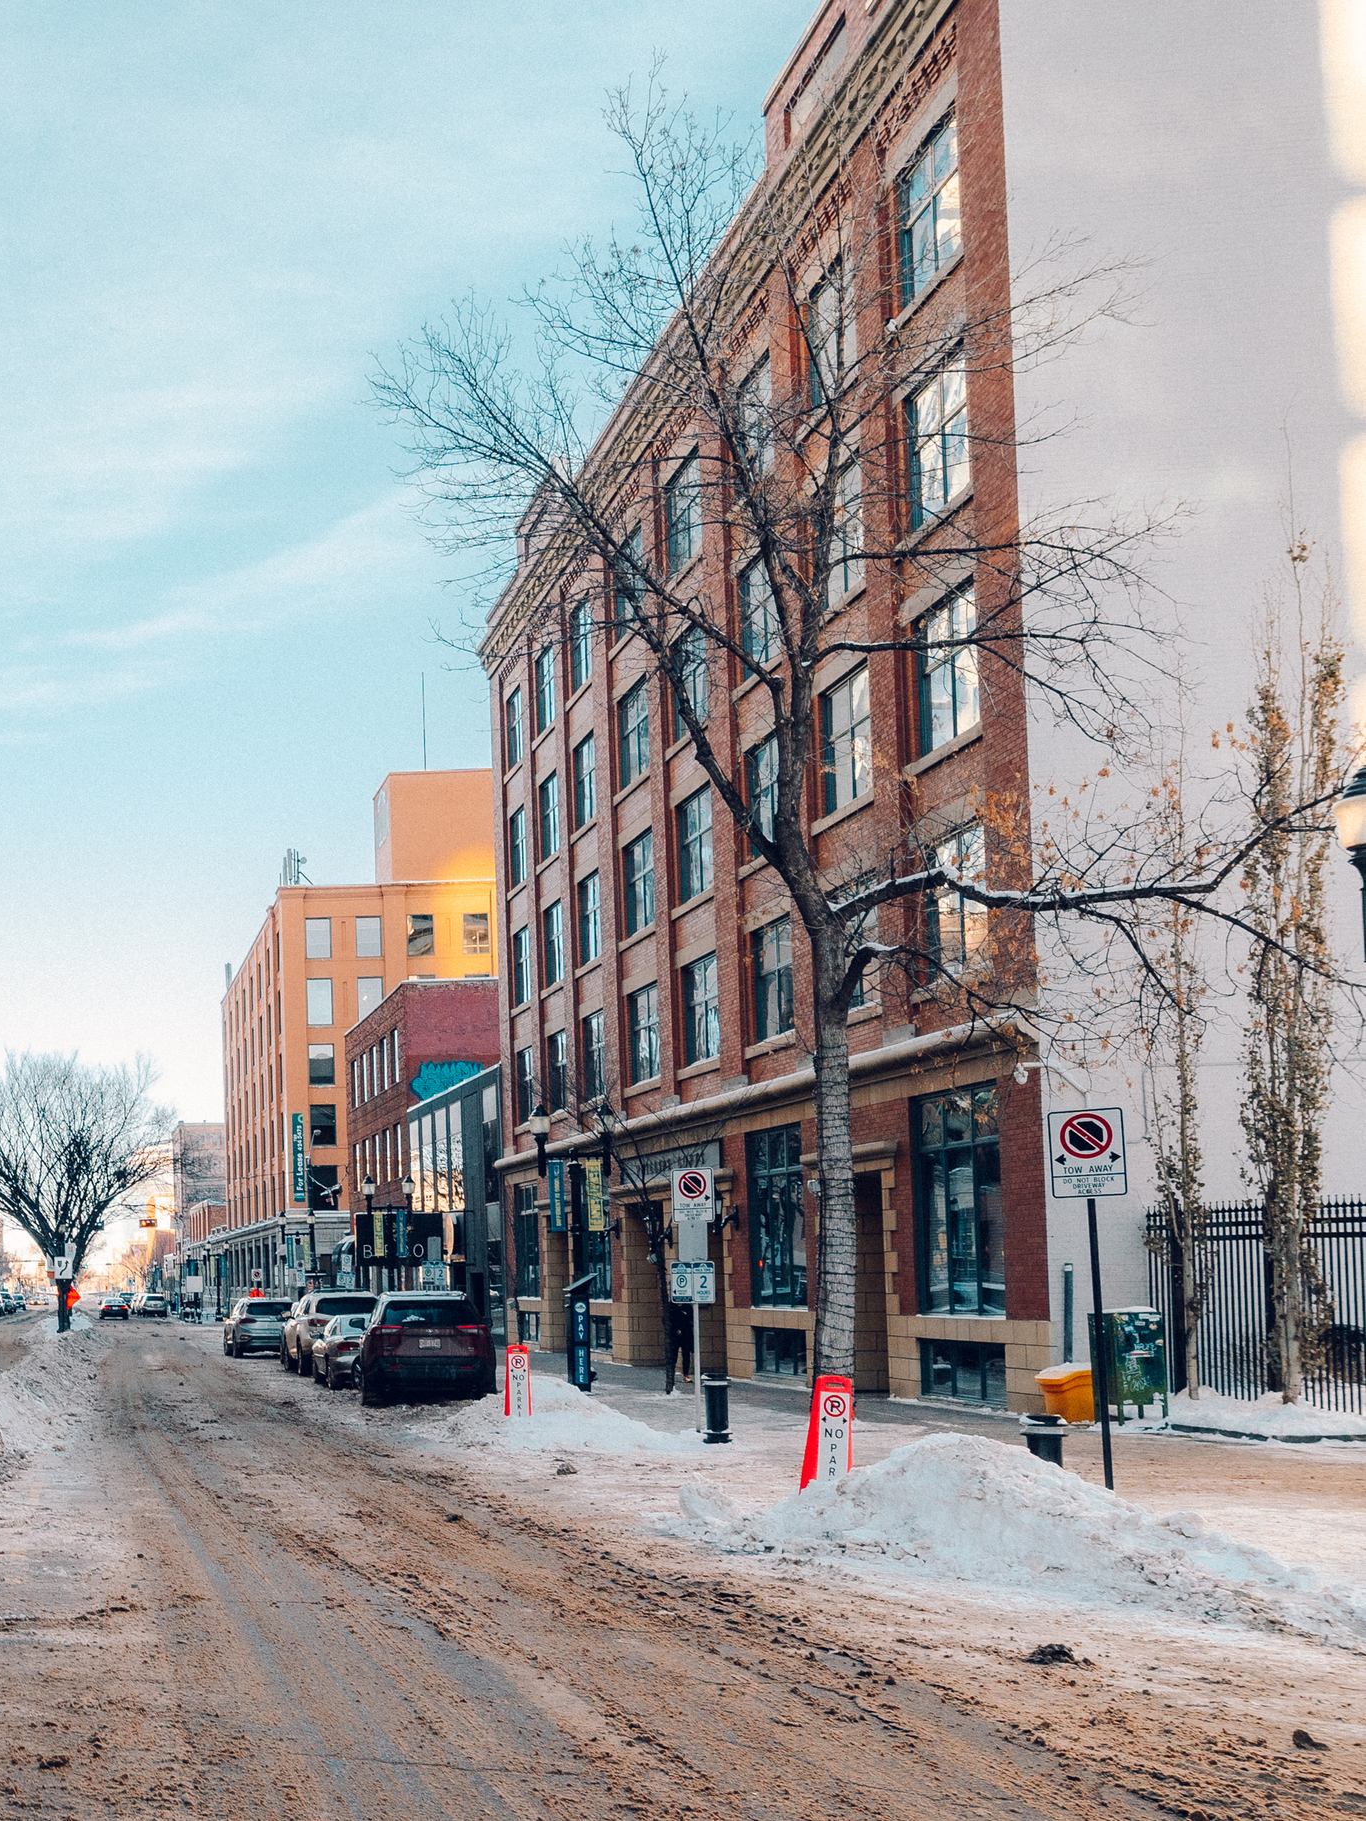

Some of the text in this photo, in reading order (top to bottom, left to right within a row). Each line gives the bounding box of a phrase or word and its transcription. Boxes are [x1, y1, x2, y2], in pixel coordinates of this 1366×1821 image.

[296, 1153, 304, 1176] Lease
[1064, 1164, 1114, 1175] TOW AWAY
[296, 1178, 304, 1191] For
[1093, 1175, 1115, 1183] BLOCK
[1072, 1182, 1106, 1190] DRIVEWAY
[699, 1275, 708, 1289] 2
[824, 1427, 844, 1439] NO
[828, 1443, 837, 1481] PAR
